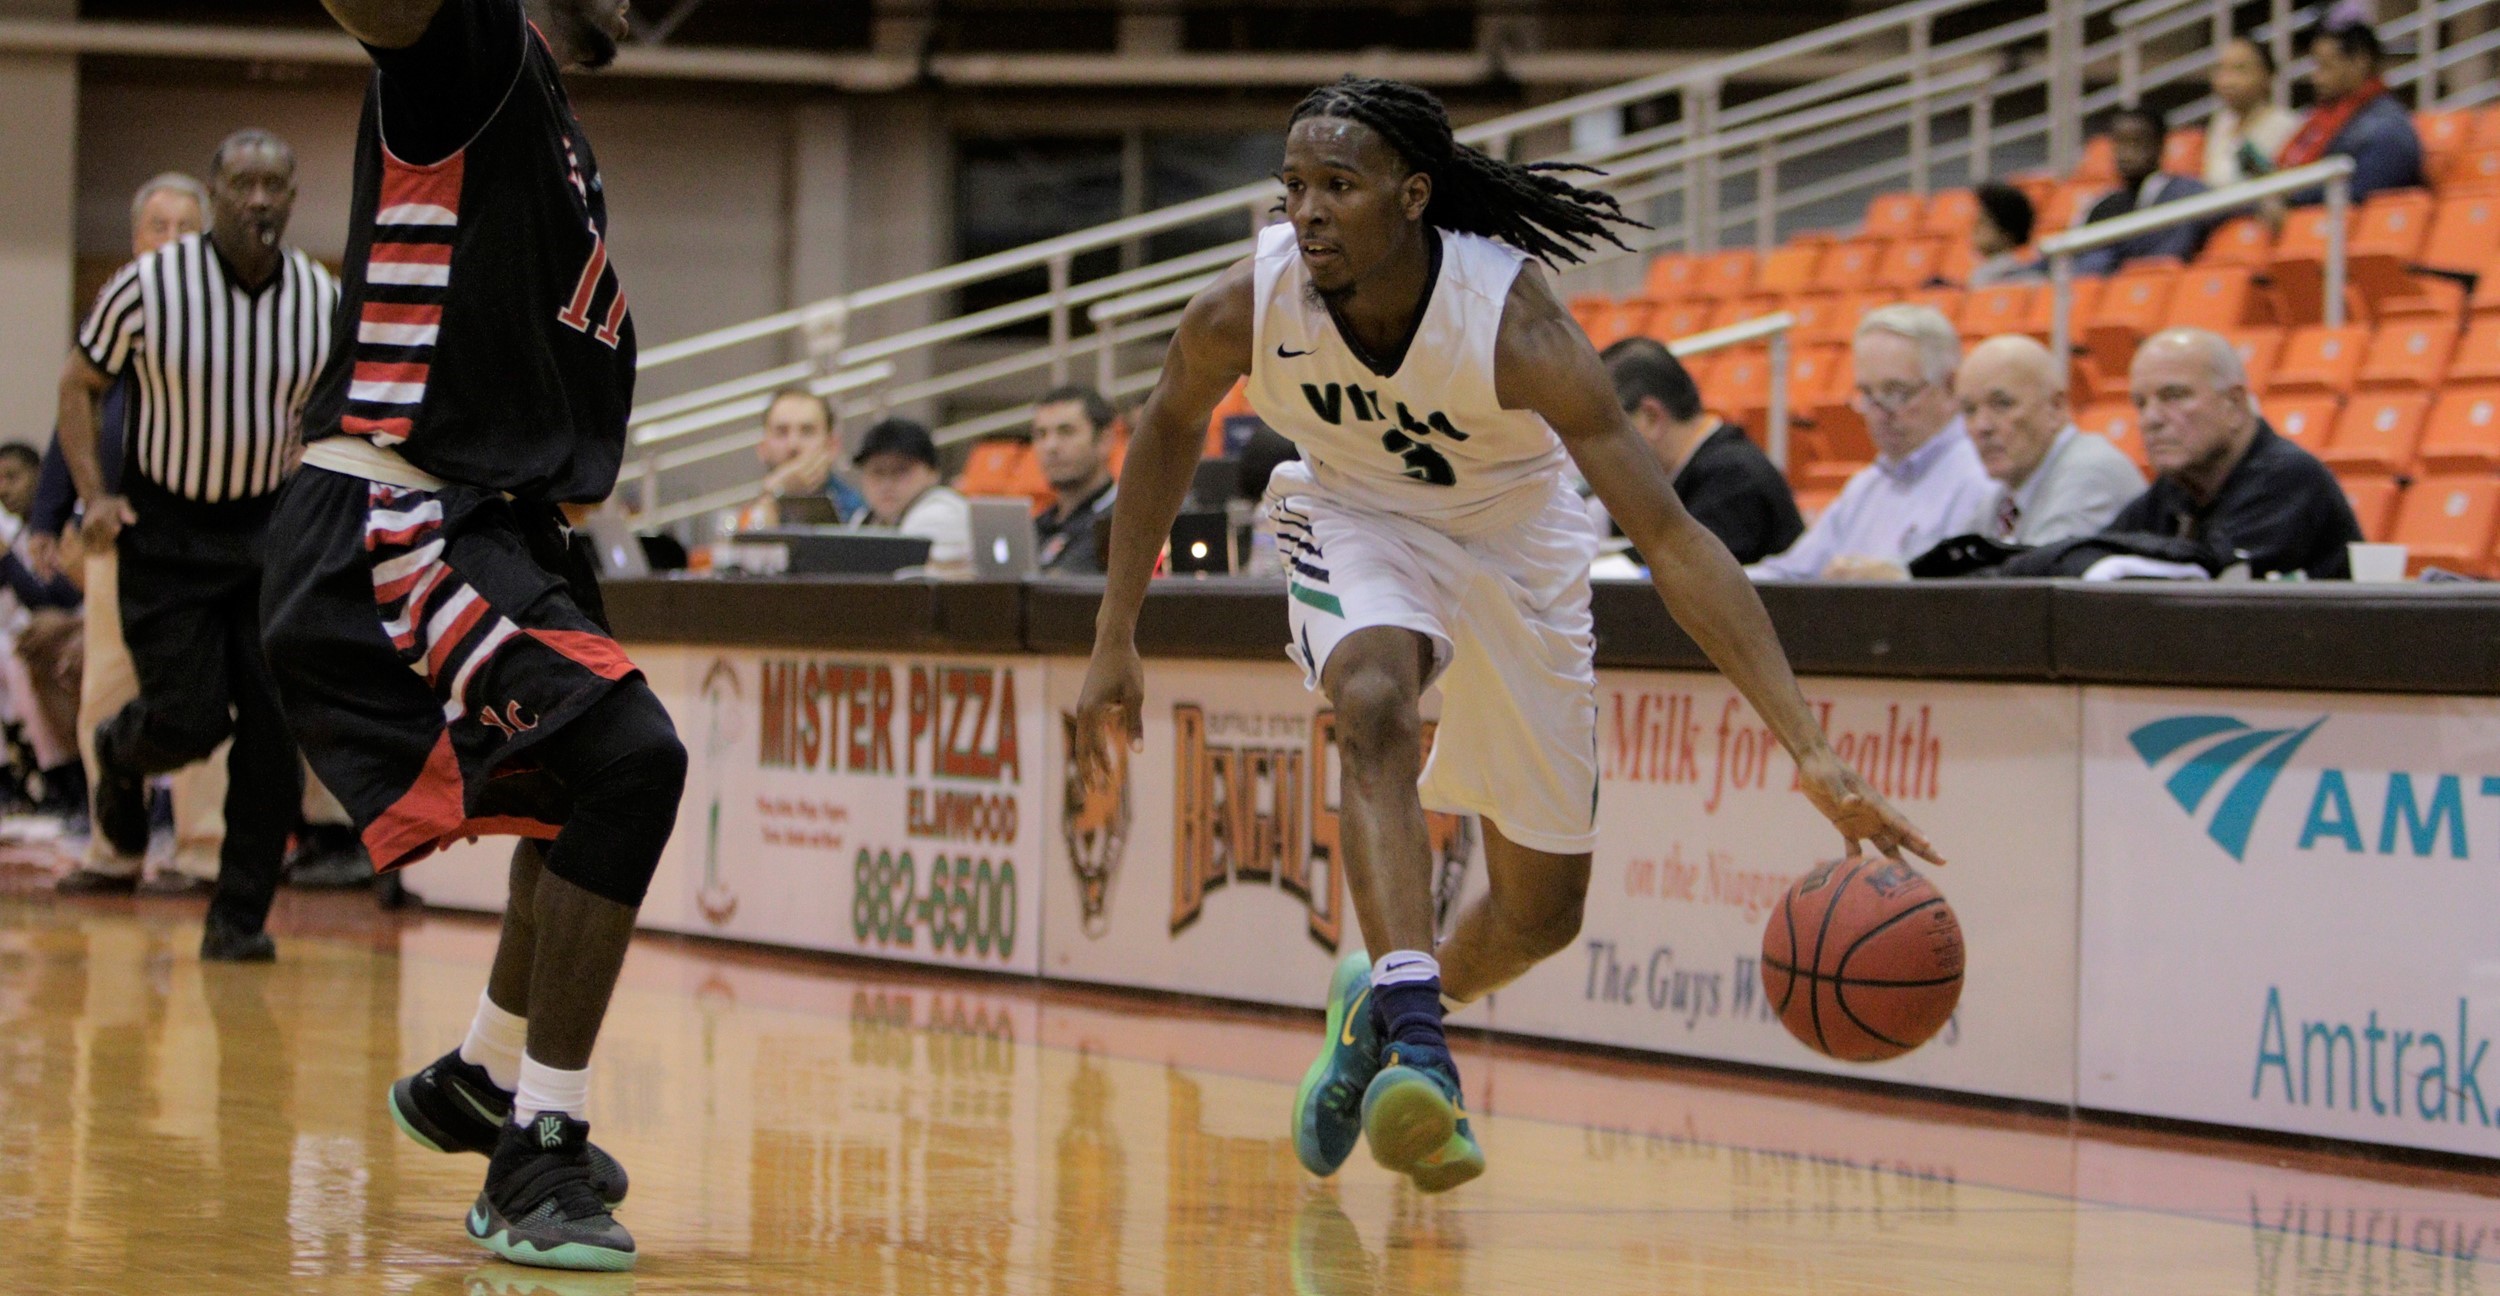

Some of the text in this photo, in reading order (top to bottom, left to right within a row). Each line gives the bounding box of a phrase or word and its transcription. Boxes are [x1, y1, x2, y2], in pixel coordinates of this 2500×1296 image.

[759, 659, 1021, 784] MISTER PIZZA
[1603, 691, 1701, 784] Milk
[1704, 695, 1778, 815] for
[906, 788, 1019, 844] ELMWOOD
[2297, 769, 2500, 860] AM
[852, 847, 1017, 960] 882-6500
[1585, 939, 1639, 1006] The
[1647, 946, 1722, 1031] Guys
